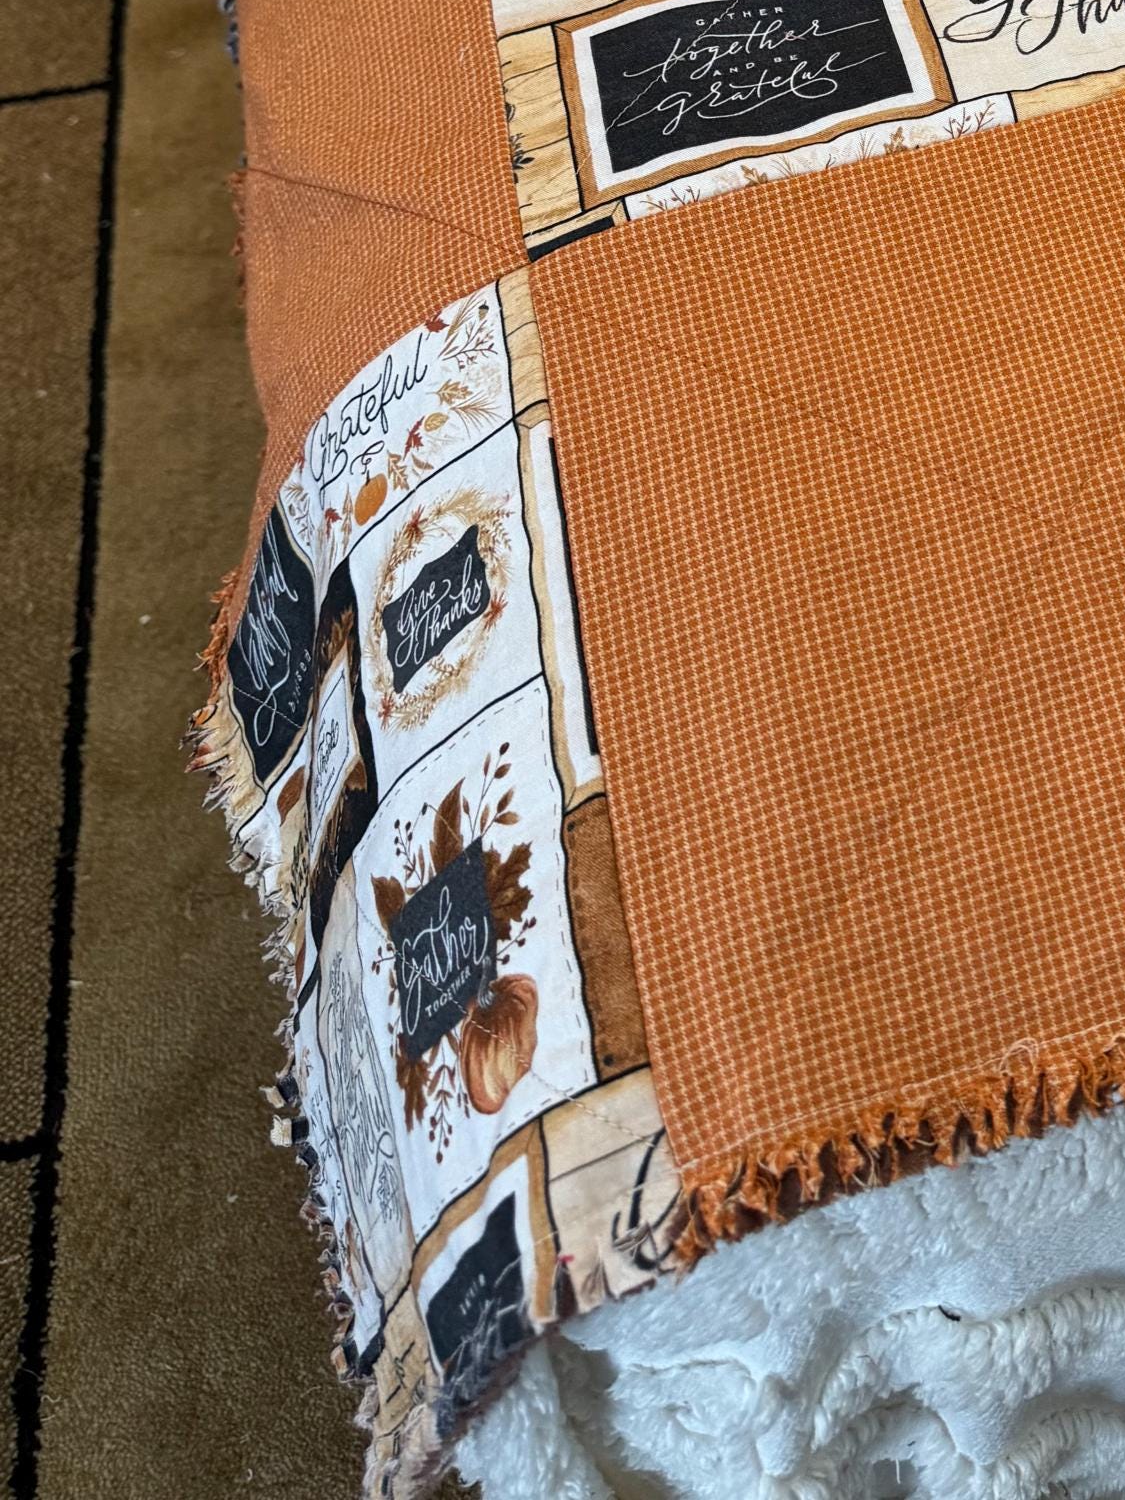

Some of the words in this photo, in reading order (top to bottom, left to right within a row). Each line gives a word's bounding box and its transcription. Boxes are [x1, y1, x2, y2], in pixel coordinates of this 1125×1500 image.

[622, 14, 880, 84] together
[695, 6, 785, 27] GATHER
[617, 51, 888, 136] grateful
[712, 62, 755, 77] AND
[773, 54, 798, 63] BE
[308, 333, 429, 511] Grateful
[414, 555, 484, 666] Thanks
[423, 963, 473, 1019] TOGETHER
